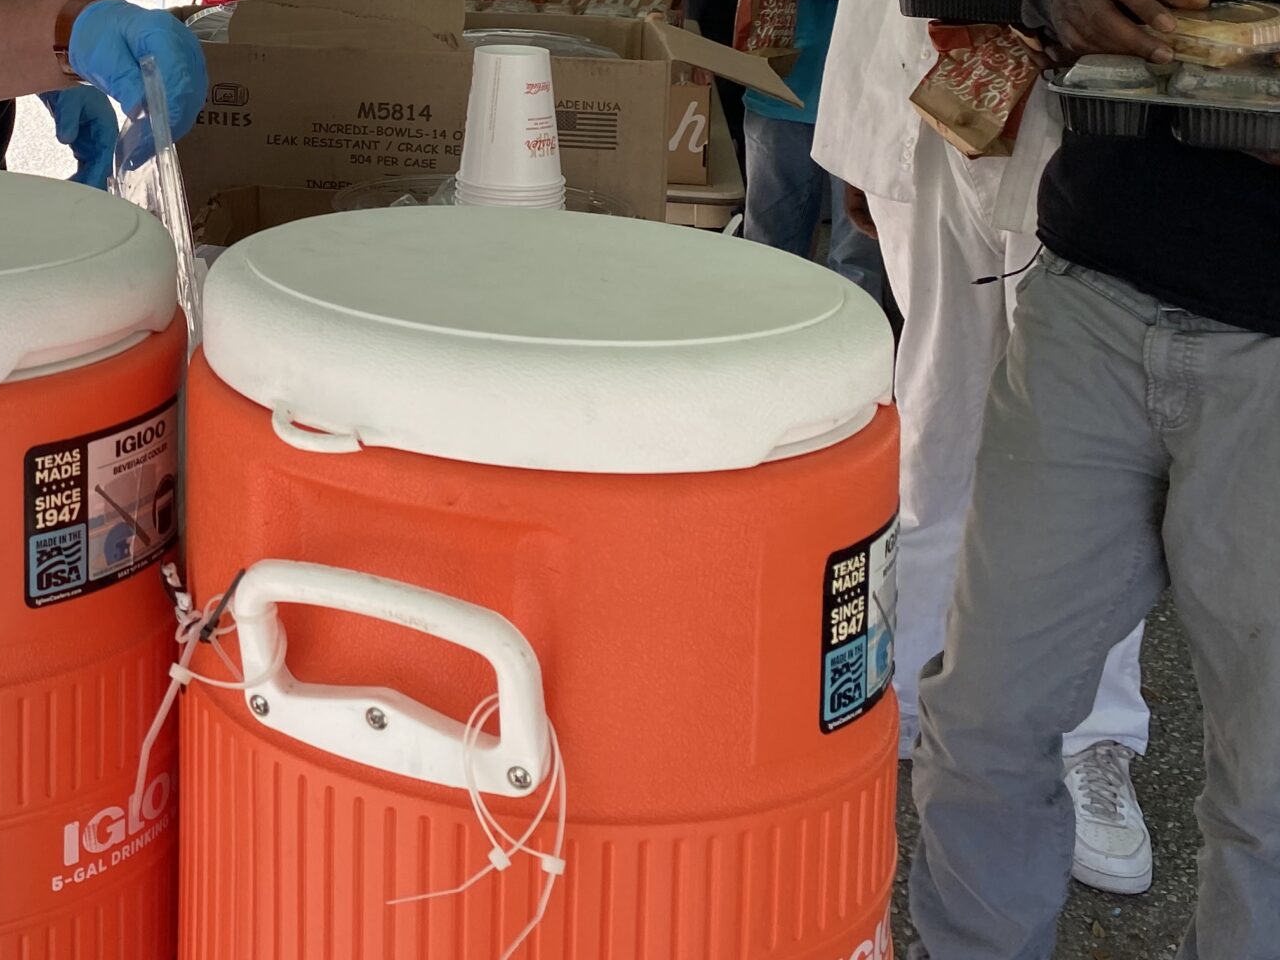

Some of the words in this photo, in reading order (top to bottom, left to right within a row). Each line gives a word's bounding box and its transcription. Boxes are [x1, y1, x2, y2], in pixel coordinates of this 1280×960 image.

[195, 110, 253, 127] ERIES
[357, 101, 433, 123] M5814
[555, 100, 581, 110] ADE
[582, 100, 595, 111] IN
[597, 101, 622, 112] USA
[311, 122, 447, 140] INCREDI-BOWLS-14
[452, 130, 463, 141] O
[266, 134, 298, 147] LEAK
[303, 137, 381, 151] RESISTANT
[397, 142, 439, 155] CRACK
[444, 144, 462, 156] RE
[350, 154, 372, 165] 504
[376, 156, 400, 167] PER
[404, 157, 438, 169] CASE
[115, 419, 166, 458] IGLOO
[35, 448, 81, 470] TEXAS
[35, 462, 81, 485] MADE
[35, 487, 81, 512] SINCE
[35, 503, 81, 530] 1947
[36, 534, 57, 549] MADE
[58, 533, 67, 545] IN
[68, 530, 82, 542] THE
[36, 565, 81, 590] USA
[832, 551, 866, 579] TEXAS
[832, 566, 865, 595] MADE
[831, 595, 865, 624] SINCE
[831, 612, 865, 645] 1947
[831, 650, 847, 668] MADE
[855, 642, 864, 657] THE
[830, 681, 862, 713] USA
[64, 772, 171, 867] IGLO
[51, 859, 108, 892] 5-GAL
[111, 814, 169, 866] DRINKING
